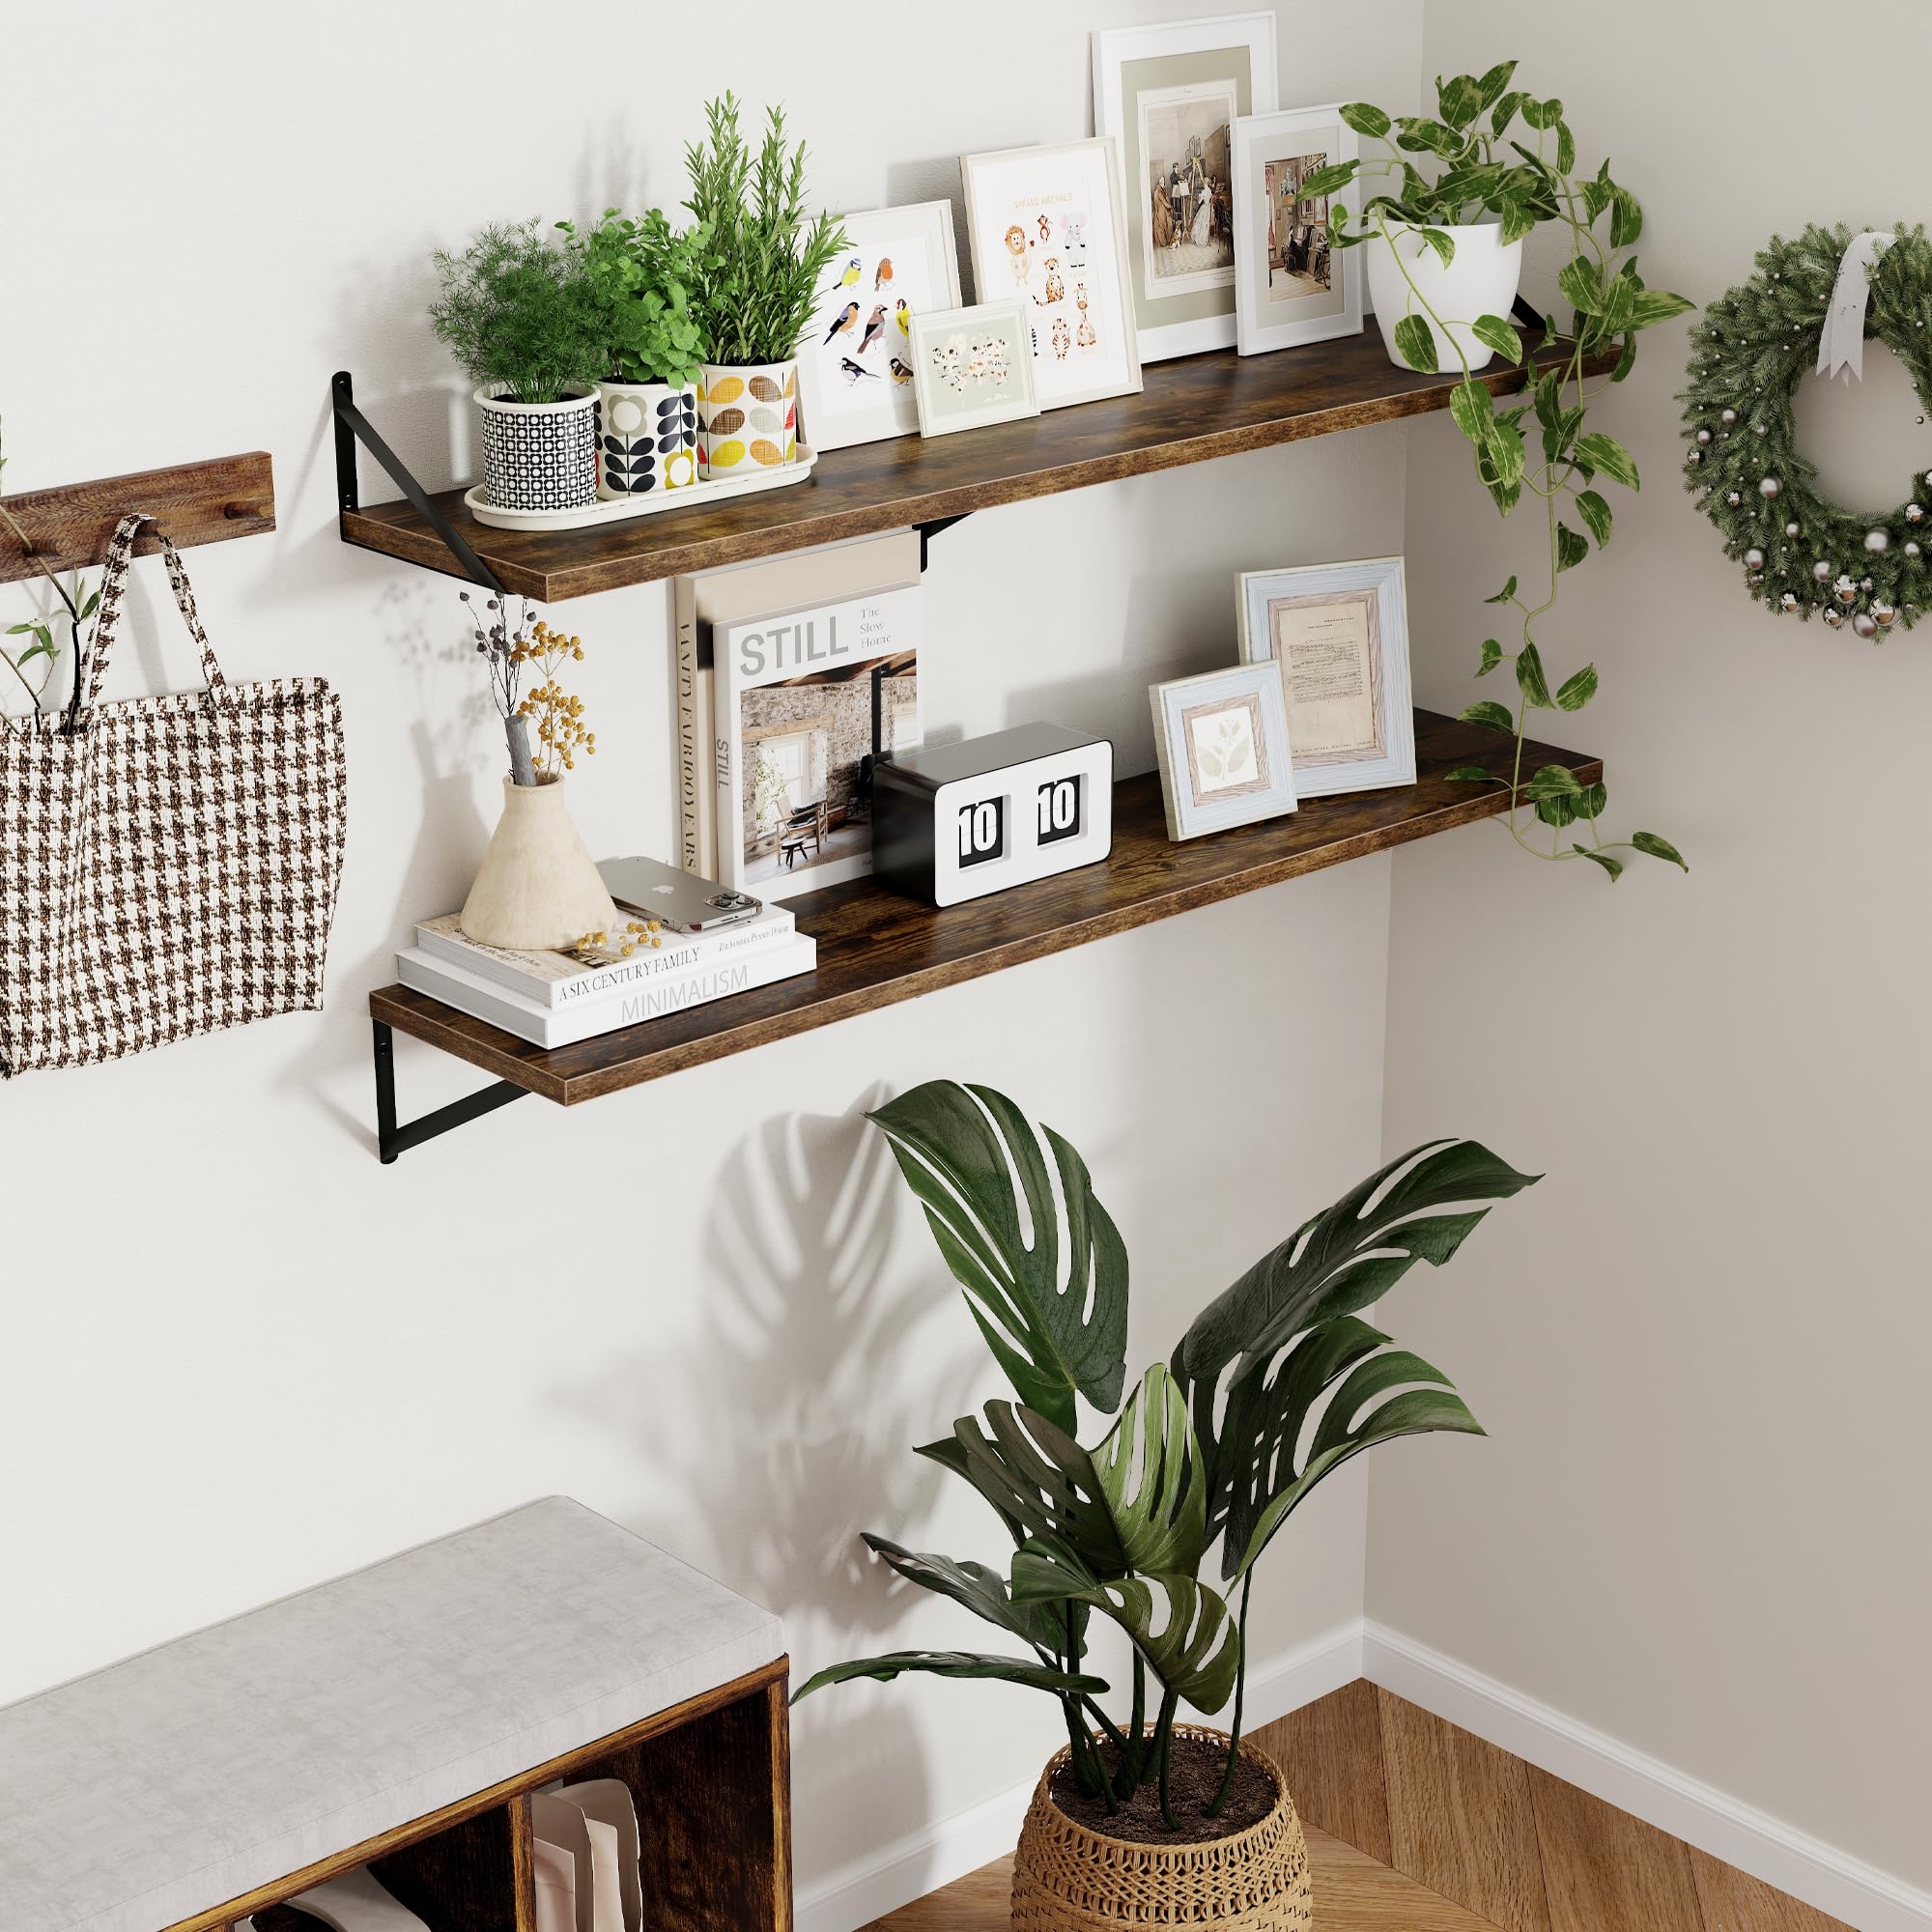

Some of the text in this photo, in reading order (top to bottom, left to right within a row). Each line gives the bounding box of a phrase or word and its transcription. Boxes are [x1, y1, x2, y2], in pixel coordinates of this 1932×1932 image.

[860, 607, 880, 619] The
[680, 623, 692, 703] VANITY
[740, 615, 849, 676] STILL
[861, 635, 892, 649] Home
[682, 706, 693, 755] FAIR
[716, 738, 729, 789] STILL
[685, 799, 696, 867] YEARS
[958, 781, 1075, 857] 10 10
[558, 946, 700, 1002] A SIX CENTURY FAMILY
[621, 964, 749, 1023] MINIMALISM
